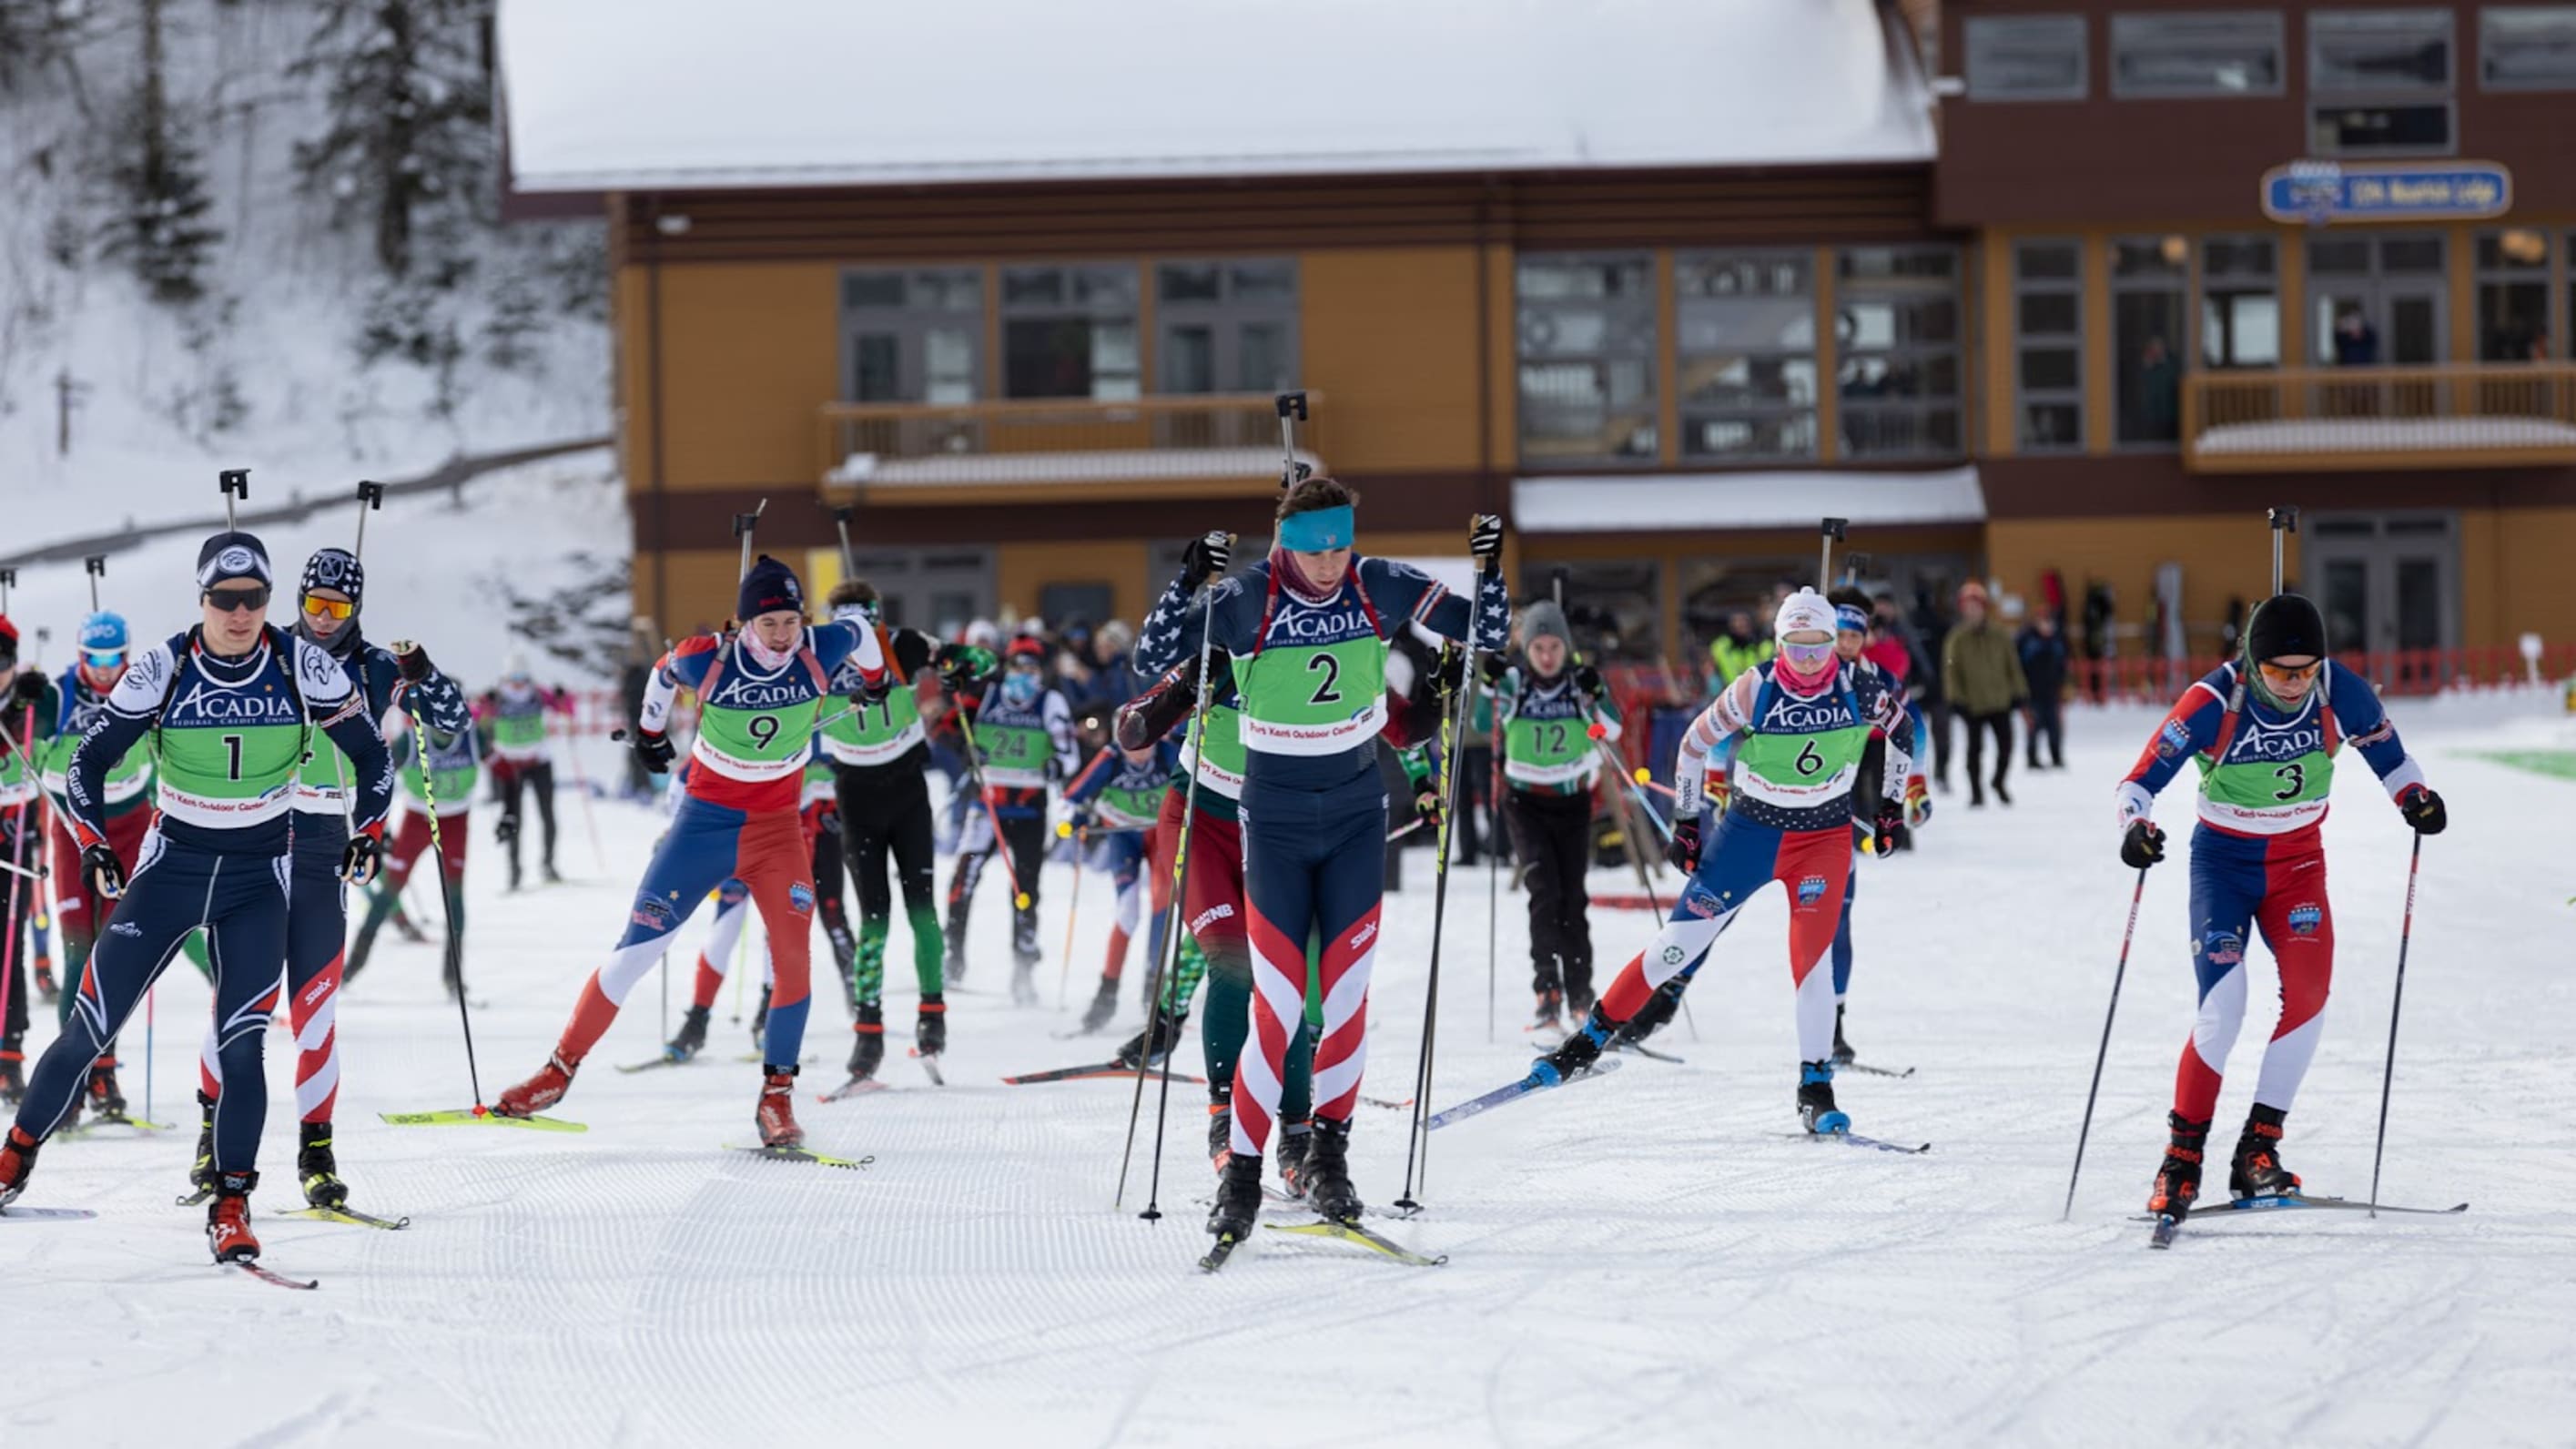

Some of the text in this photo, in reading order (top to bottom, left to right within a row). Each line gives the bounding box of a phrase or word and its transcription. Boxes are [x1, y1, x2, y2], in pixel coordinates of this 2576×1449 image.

[1265, 603, 1374, 641] ACADIA
[714, 676, 812, 704] ACADIA
[1306, 652, 1343, 705] 2
[171, 681, 295, 719] ACADIA
[1761, 697, 1853, 728] ACADIA
[746, 714, 781, 752] 9
[991, 729, 1028, 759] 24
[1533, 724, 1567, 755] 12
[2230, 724, 2325, 757] ACADI
[222, 734, 243, 782] 1
[1794, 738, 1825, 777] 6
[2273, 763, 2306, 800] 3
[1210, 903, 1234, 920] NB
